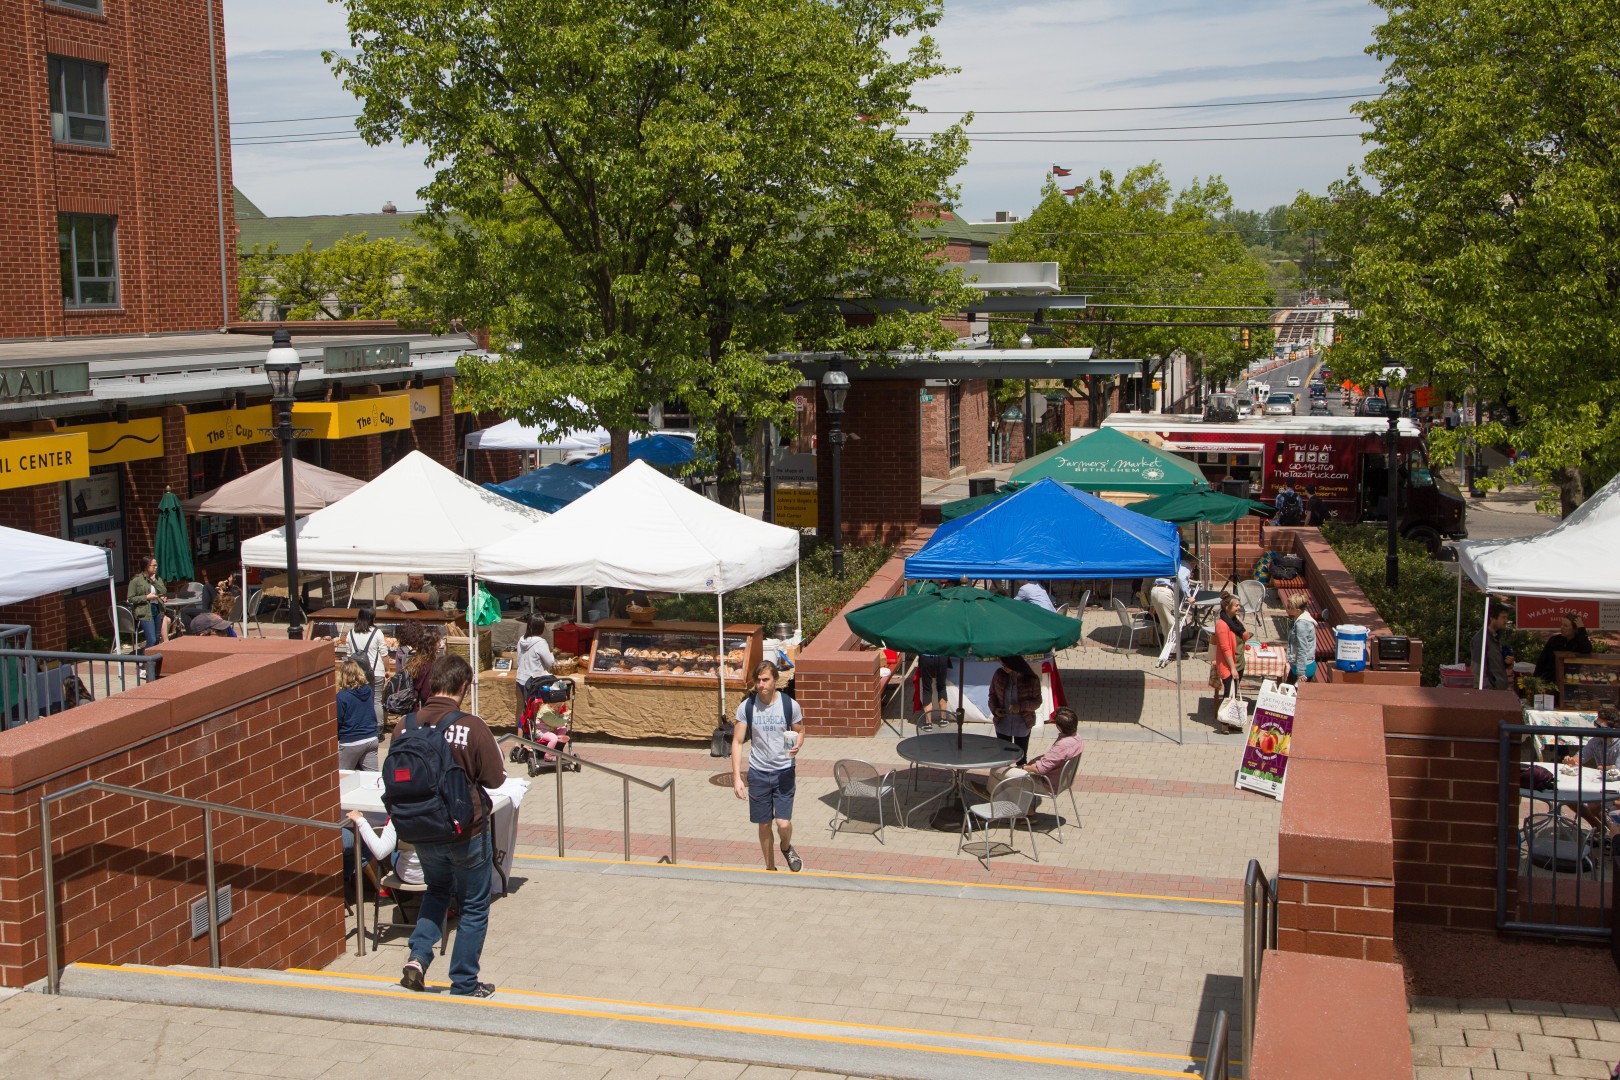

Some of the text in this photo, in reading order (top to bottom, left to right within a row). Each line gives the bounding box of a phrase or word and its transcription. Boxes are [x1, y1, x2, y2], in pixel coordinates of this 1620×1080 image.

[356, 411, 394, 430] The Cup
[206, 424, 253, 444] The Cup
[1288, 443, 1307, 451] Find
[1309, 443, 1319, 451] Us
[19, 450, 73, 471] CENTER
[1113, 456, 1163, 468] Market
[1527, 607, 1555, 620] WARM
[1559, 606, 1589, 620] SUGAR
